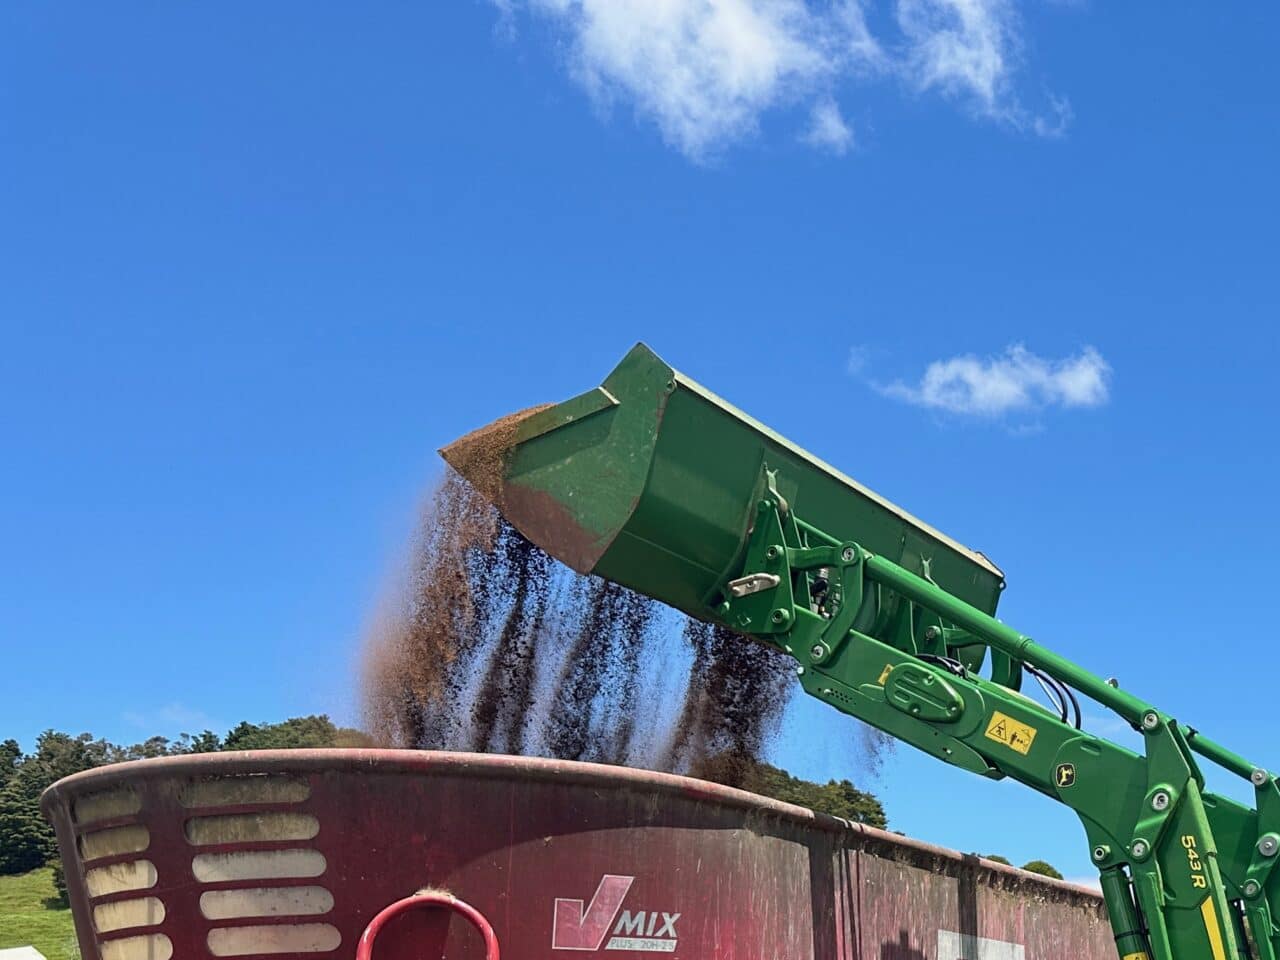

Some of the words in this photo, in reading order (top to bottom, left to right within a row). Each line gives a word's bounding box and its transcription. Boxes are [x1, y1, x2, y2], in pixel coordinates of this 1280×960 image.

[1181, 835, 1202, 871] 543
[1191, 874, 1206, 889] R
[612, 909, 682, 938] MIX
